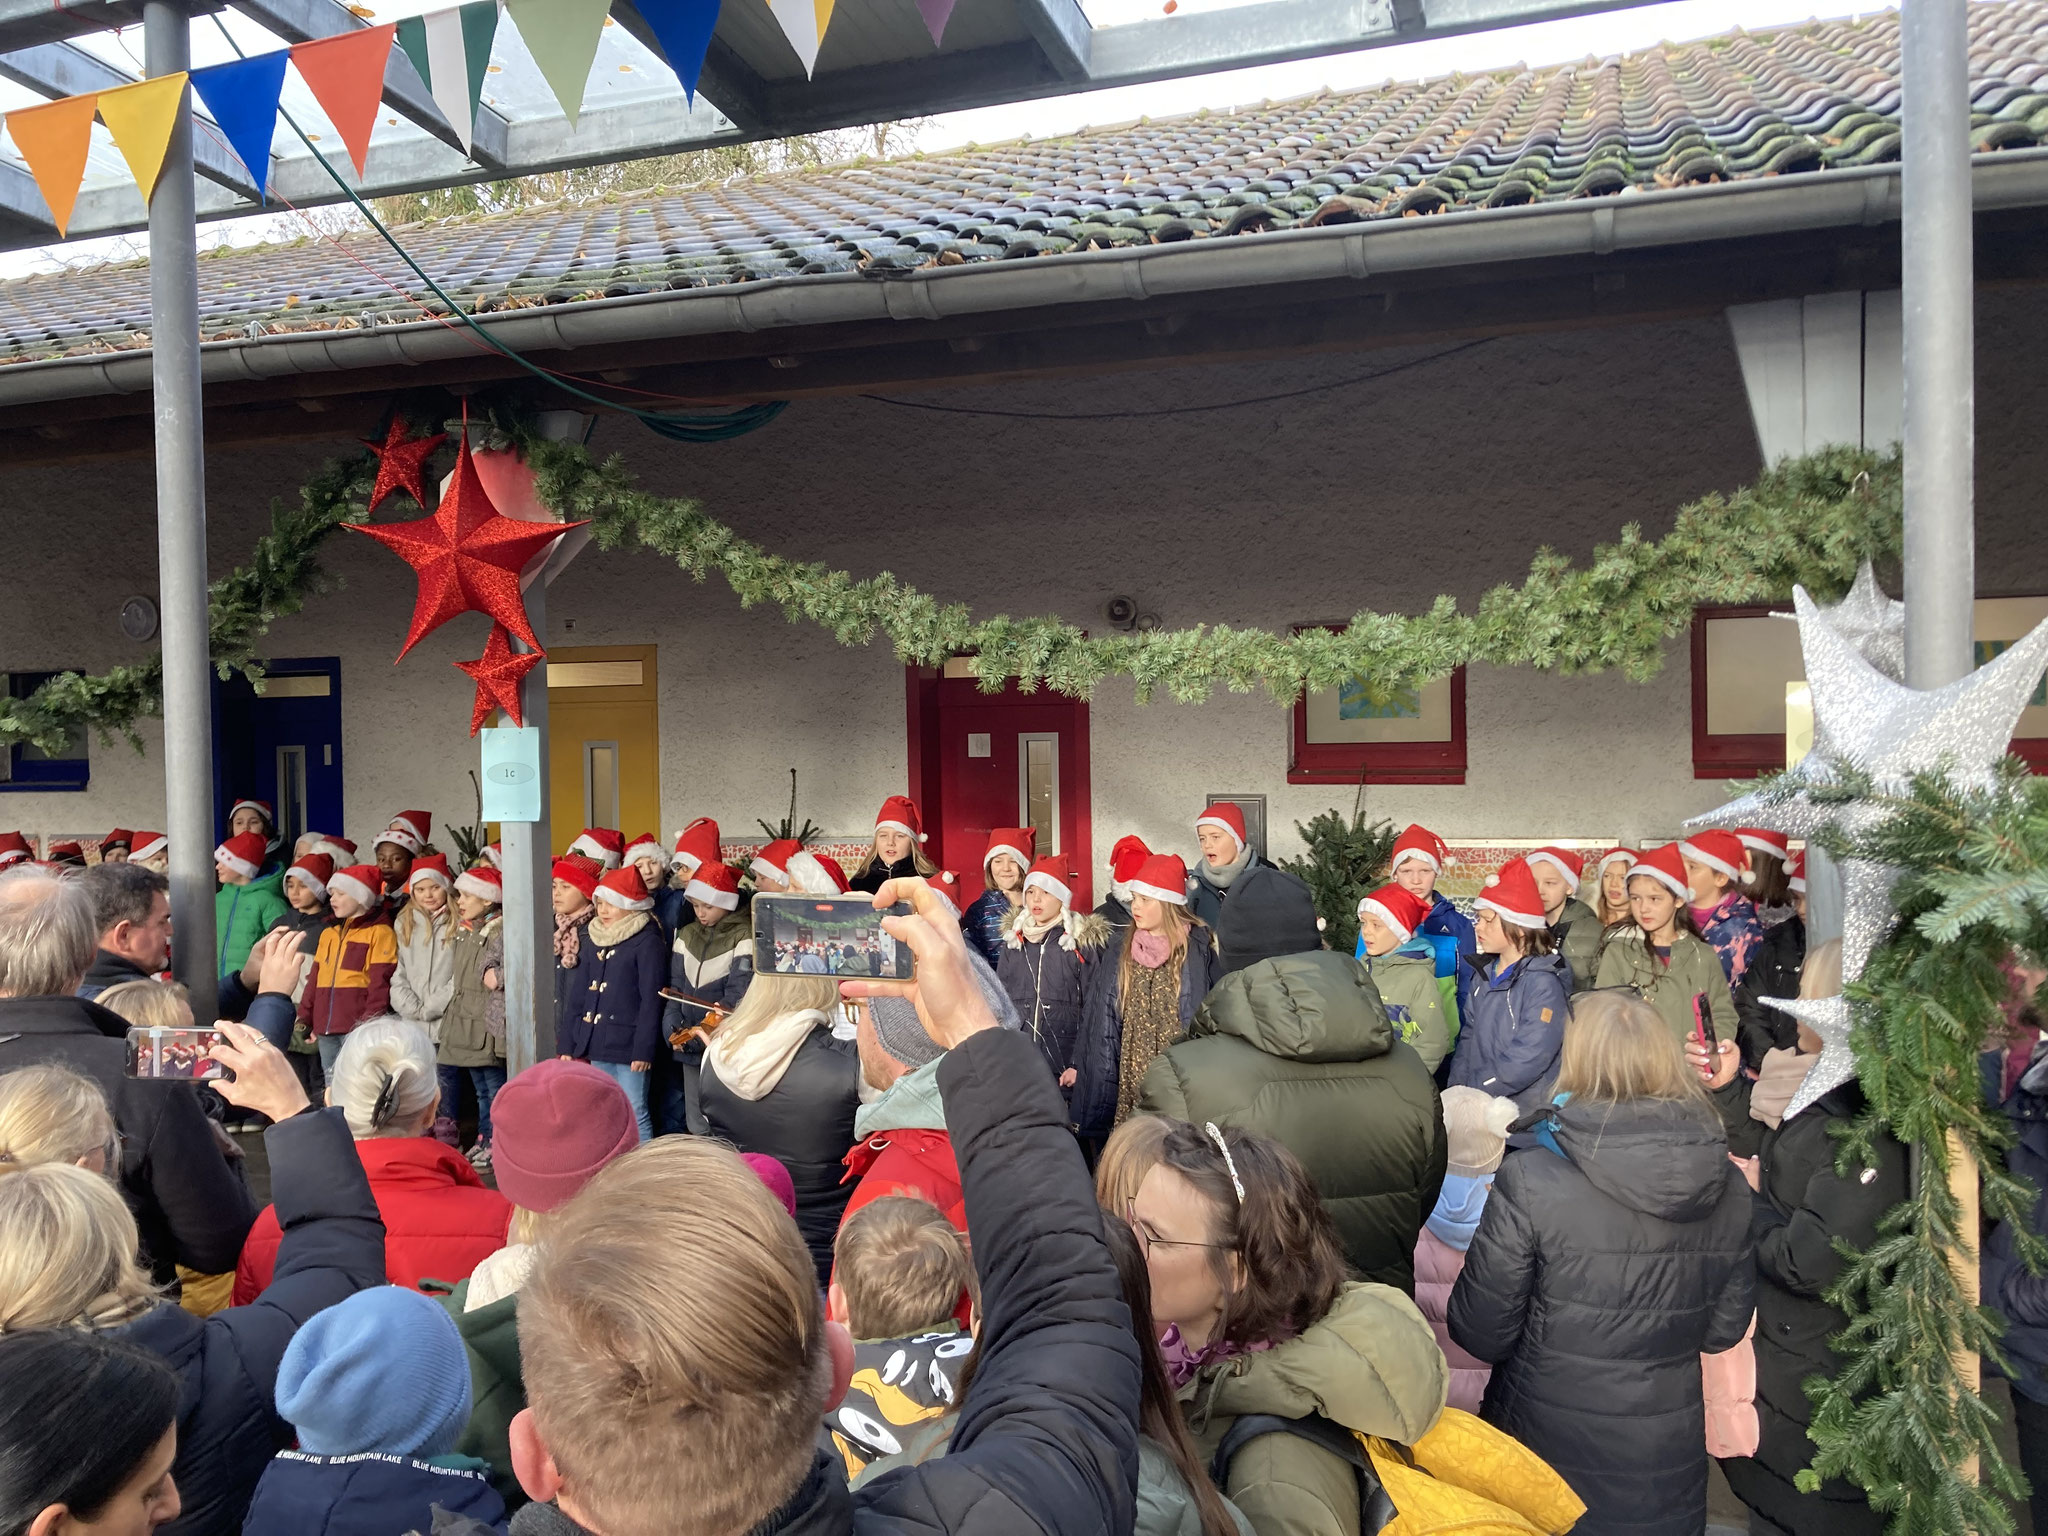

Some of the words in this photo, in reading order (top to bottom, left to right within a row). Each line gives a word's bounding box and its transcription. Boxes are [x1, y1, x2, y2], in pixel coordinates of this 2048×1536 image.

[305, 1454, 322, 1465] LAKE
[330, 1455, 346, 1464] BLUE
[346, 1452, 382, 1463] MOUNTAIN
[382, 1453, 402, 1464] LAKE
[412, 1459, 430, 1472] BLUE
[430, 1466, 461, 1476] MOUNTAIN
[461, 1470, 474, 1479] LAKE
